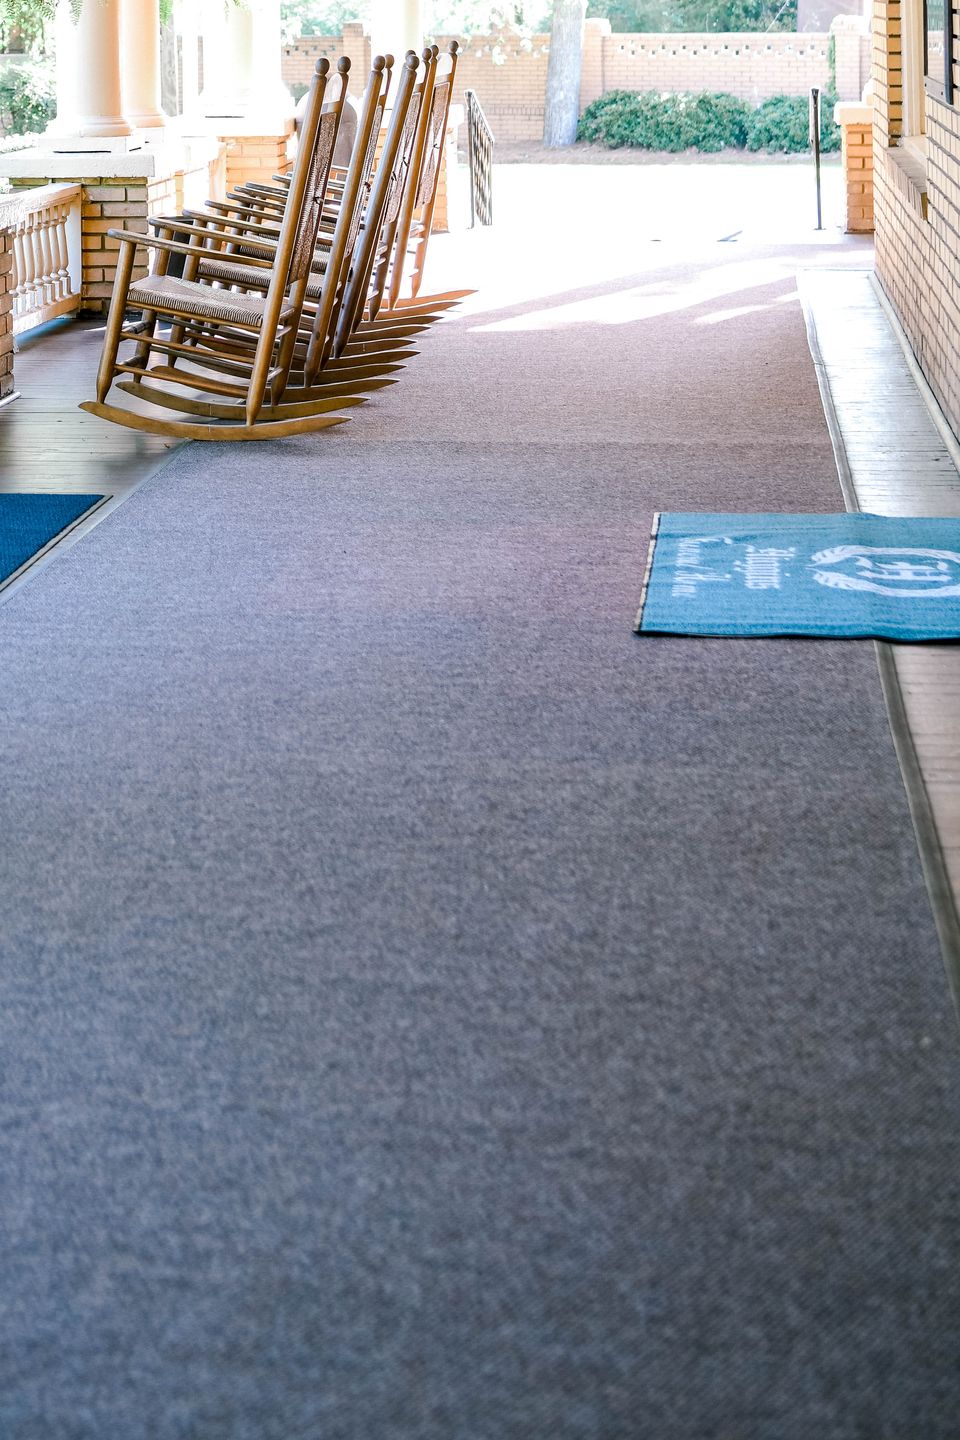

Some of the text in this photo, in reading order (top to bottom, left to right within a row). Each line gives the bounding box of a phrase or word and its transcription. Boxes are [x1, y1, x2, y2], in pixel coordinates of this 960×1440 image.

[671, 536, 733, 598] Funeral Home
[732, 544, 797, 590] Higgins
